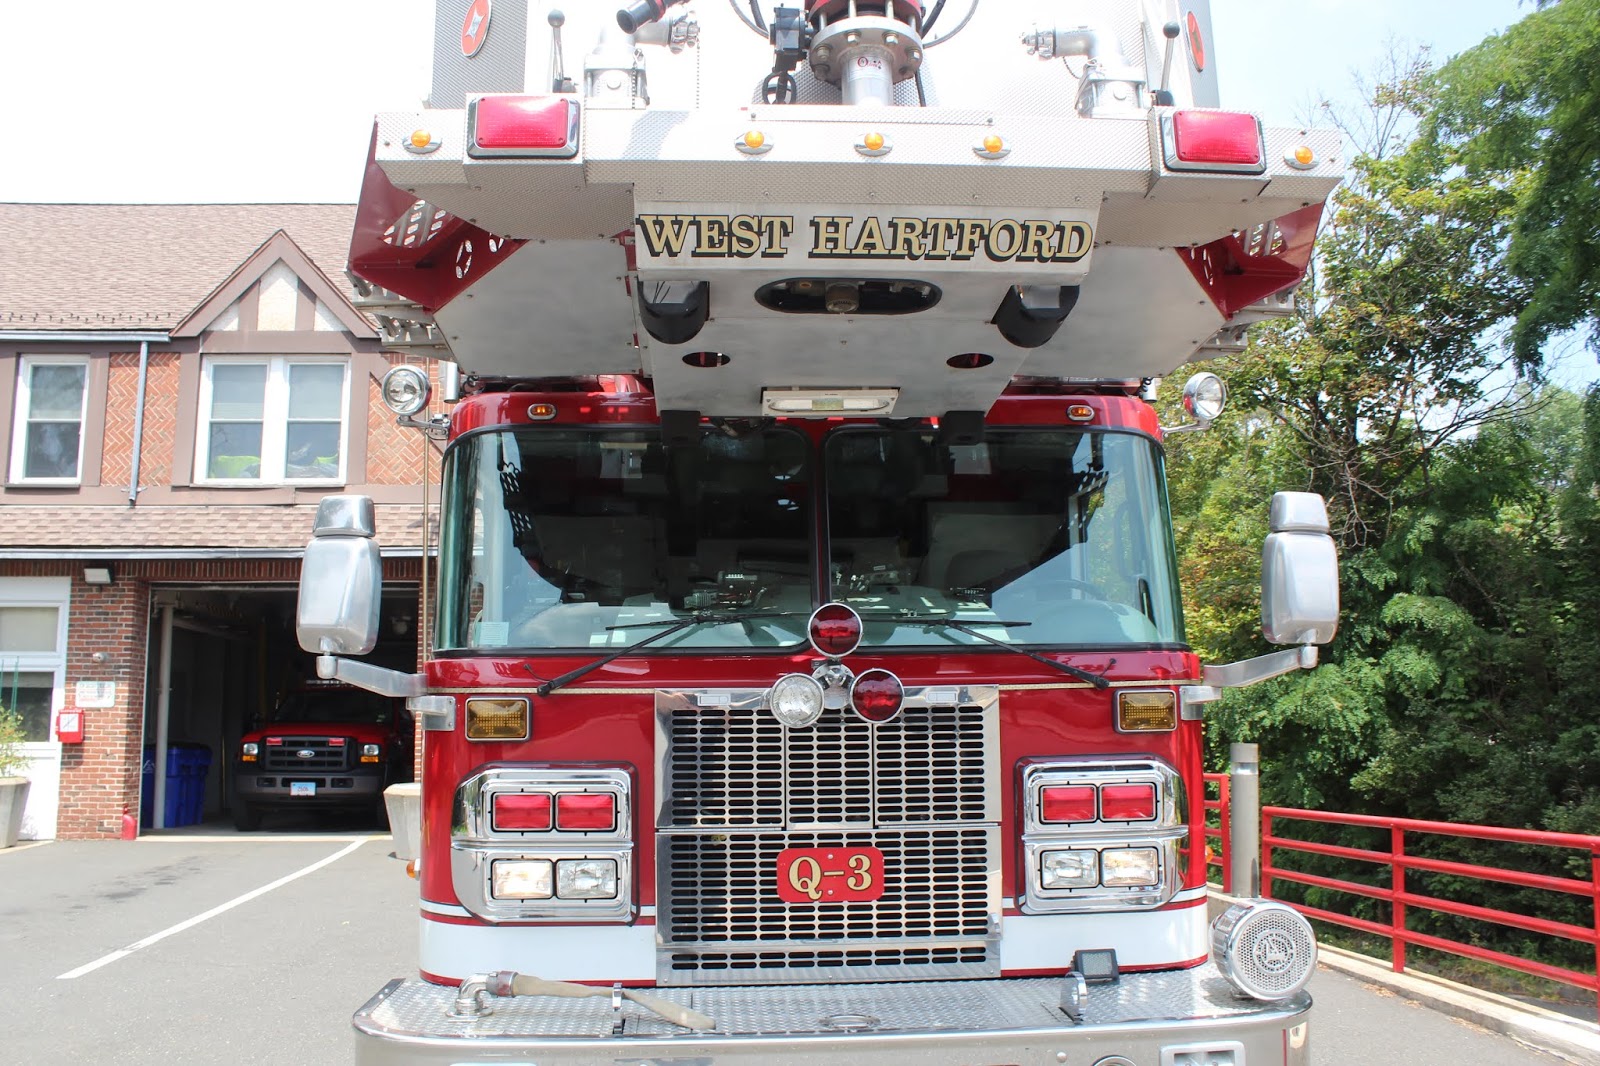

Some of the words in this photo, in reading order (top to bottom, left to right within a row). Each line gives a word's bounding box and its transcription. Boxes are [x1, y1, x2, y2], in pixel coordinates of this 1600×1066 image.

[635, 213, 794, 258] WEST
[808, 215, 1094, 262] HARTFORD
[788, 854, 873, 900] Q-3
